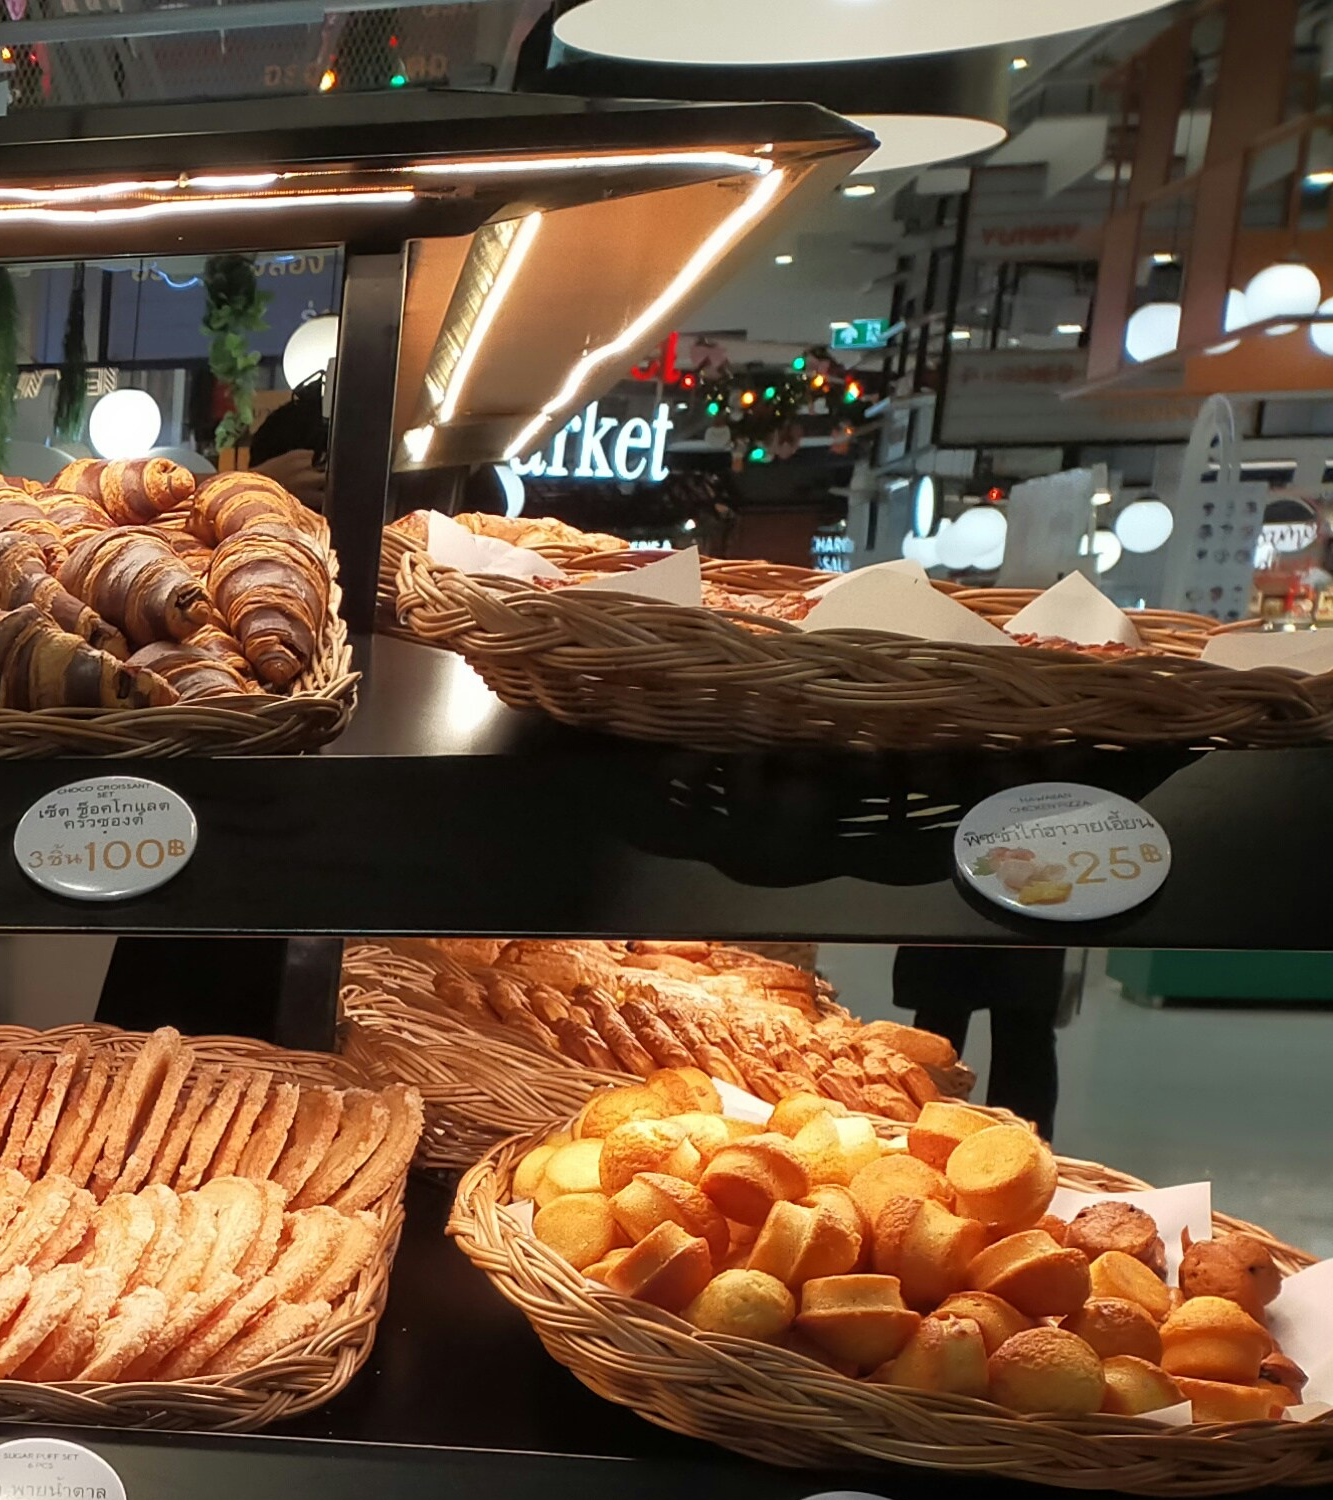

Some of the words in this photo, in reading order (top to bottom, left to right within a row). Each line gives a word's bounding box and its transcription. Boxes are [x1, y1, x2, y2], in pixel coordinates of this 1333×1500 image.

[57, 786, 93, 795] CHOCO
[96, 783, 153, 792] CROISSANT
[27, 851, 43, 869] 3
[3, 1452, 33, 1461] SUGAR
[35, 1453, 58, 1461] PUFF
[60, 1453, 78, 1461] SET
